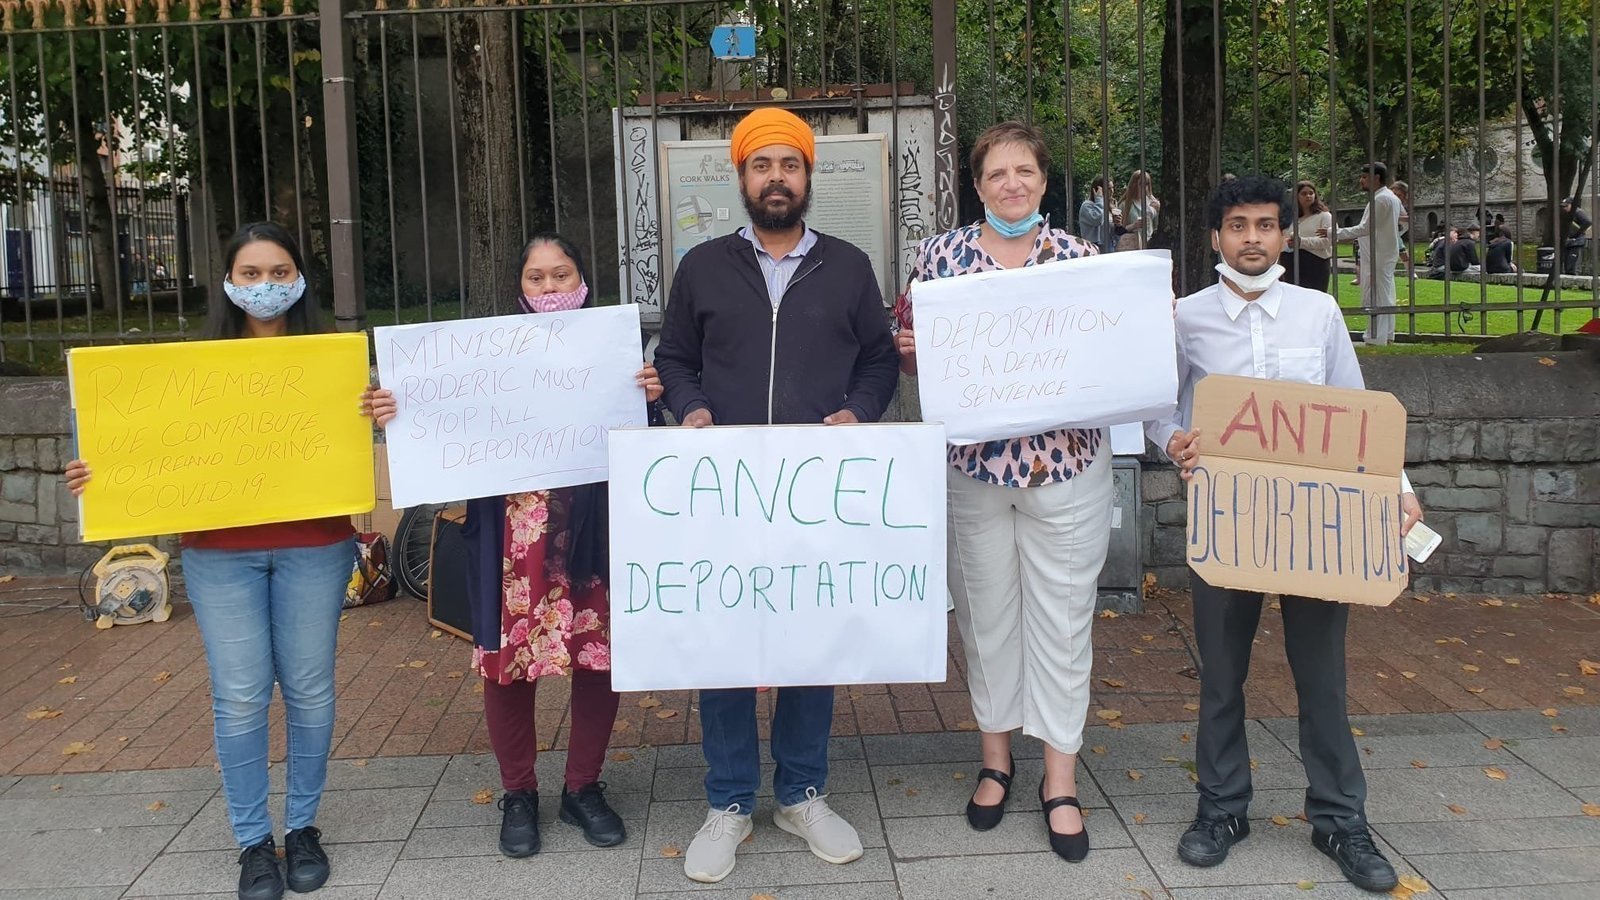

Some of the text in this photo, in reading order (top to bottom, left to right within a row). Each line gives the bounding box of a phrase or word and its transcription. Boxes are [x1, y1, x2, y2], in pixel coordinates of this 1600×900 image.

[680, 175, 702, 183] CORK
[390, 318, 566, 379] MINISTER
[931, 304, 1123, 351] DEPORTATION
[401, 366, 596, 410] RODERIC MUST
[941, 348, 1069, 382] IS A DEATH
[88, 364, 309, 430] REMEMBER
[958, 379, 1069, 409] SENTENCE
[96, 411, 320, 456] WE CONTRIBUTE
[410, 405, 537, 440] STOP ALL
[442, 419, 634, 470] DEPORTATION
[104, 433, 330, 491] TO IRELAND DURING
[643, 455, 928, 529] CANCEL
[1191, 466, 1407, 582] DEPORTATION
[624, 559, 927, 614] DEPORTATION
